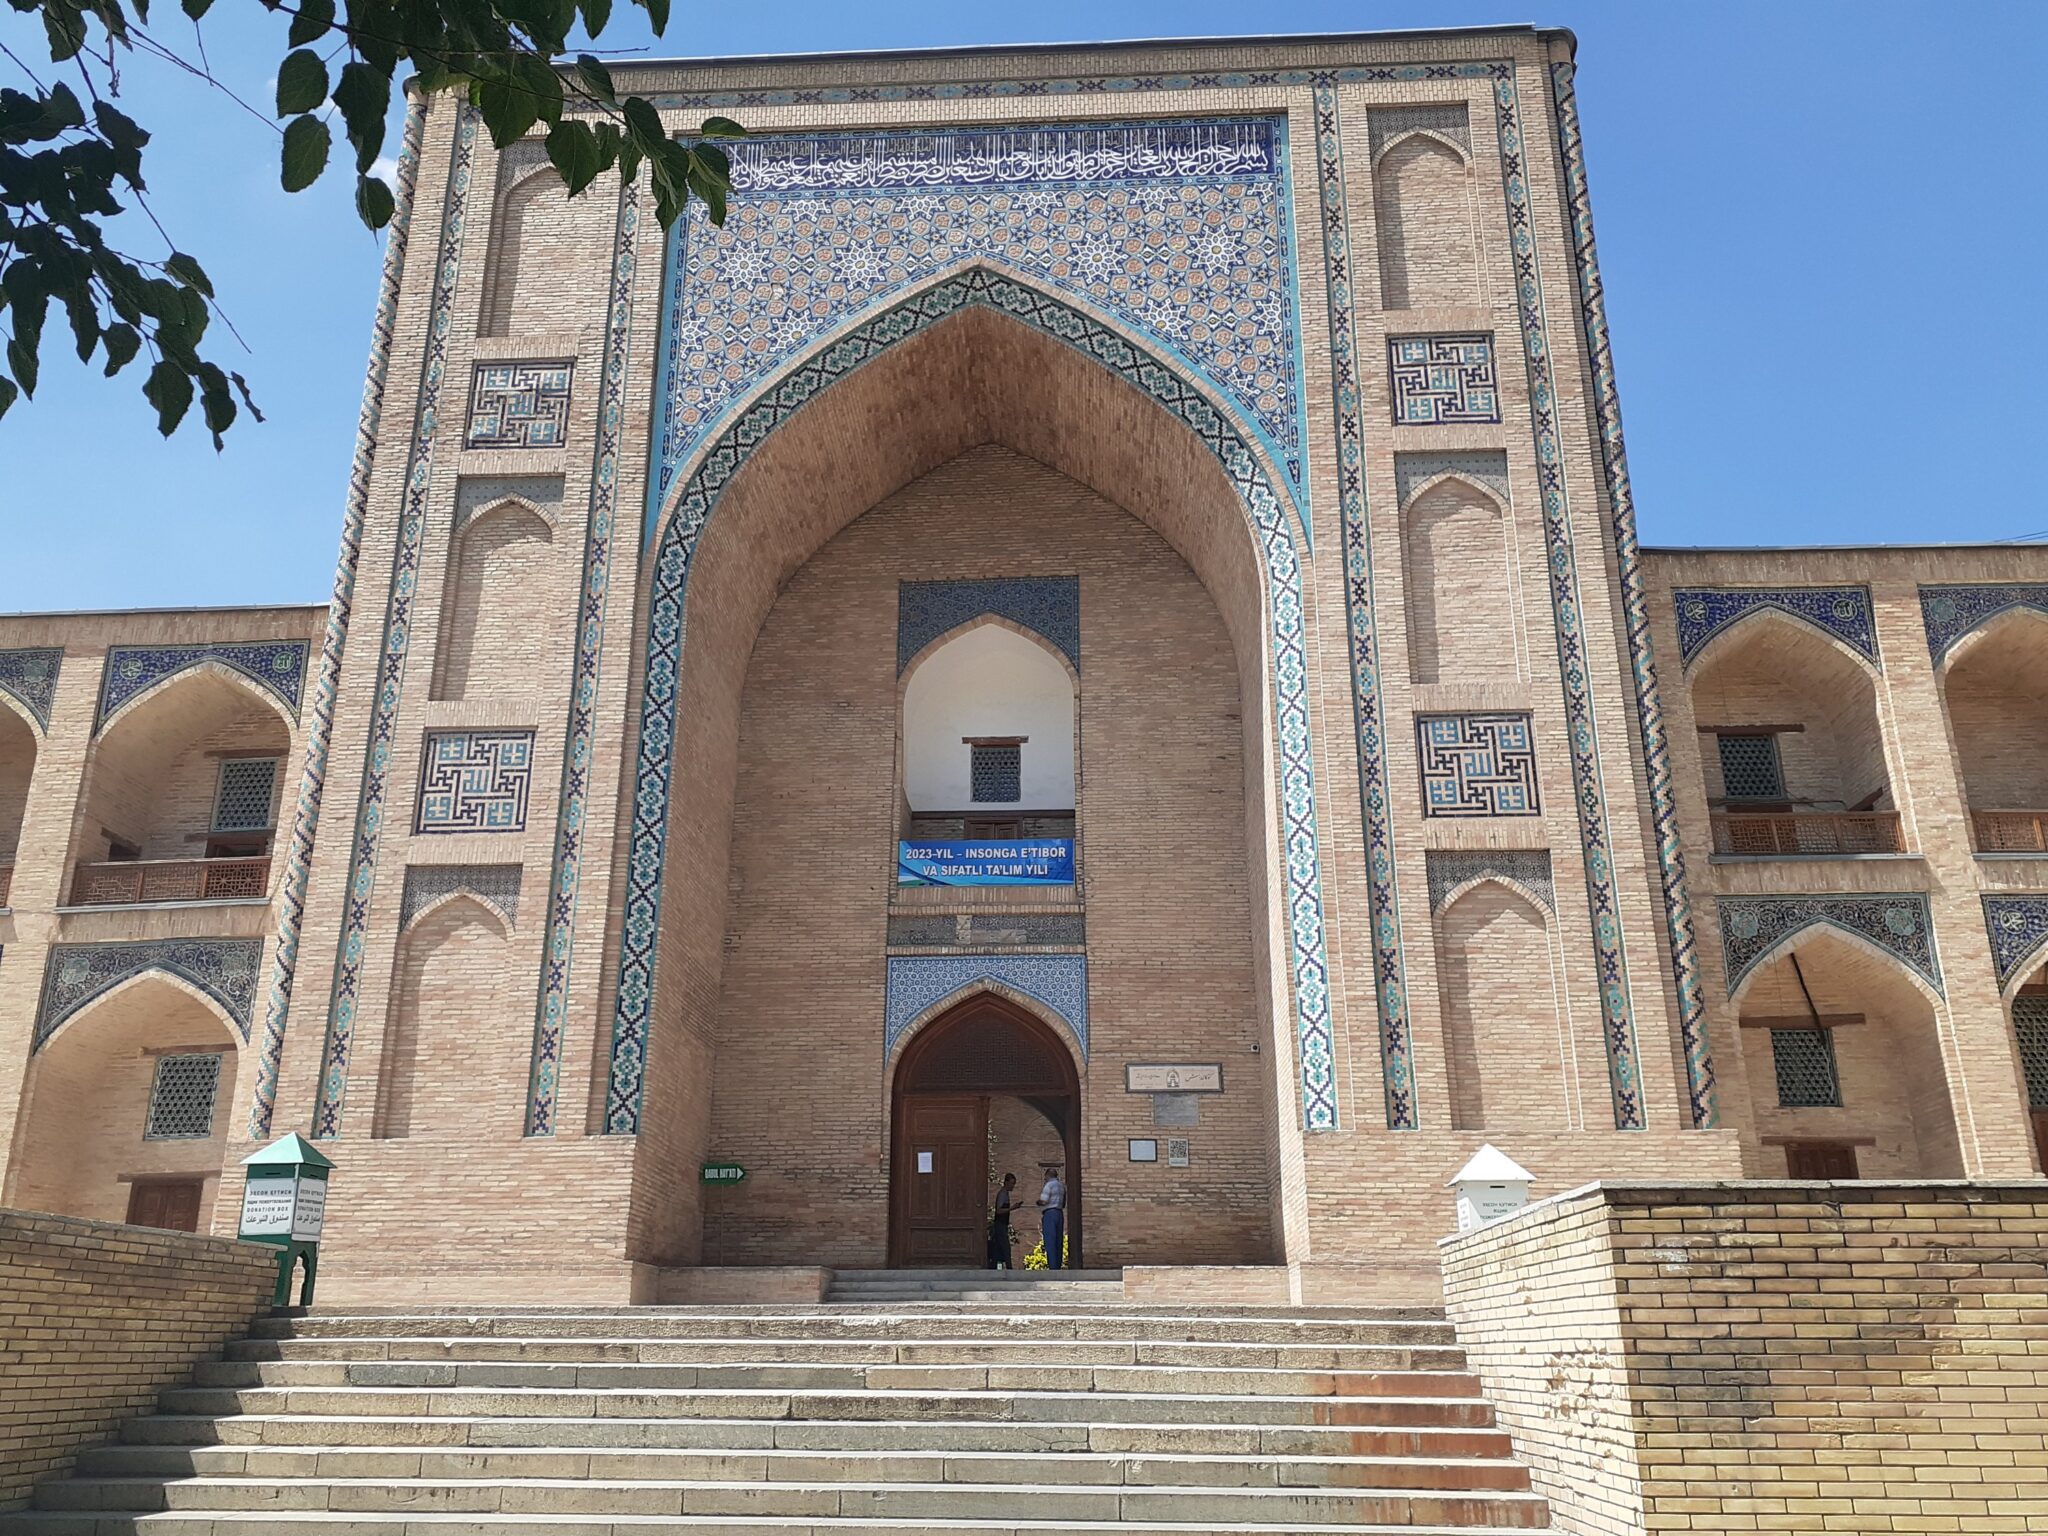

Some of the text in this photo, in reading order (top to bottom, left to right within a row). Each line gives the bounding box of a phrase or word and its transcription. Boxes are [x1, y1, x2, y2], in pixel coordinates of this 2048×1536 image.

[965, 848, 1017, 859] INSONGA
[1021, 847, 1066, 858] E'TIBOR
[922, 864, 1048, 876] VA SIFATLI TA'LIM YILI
